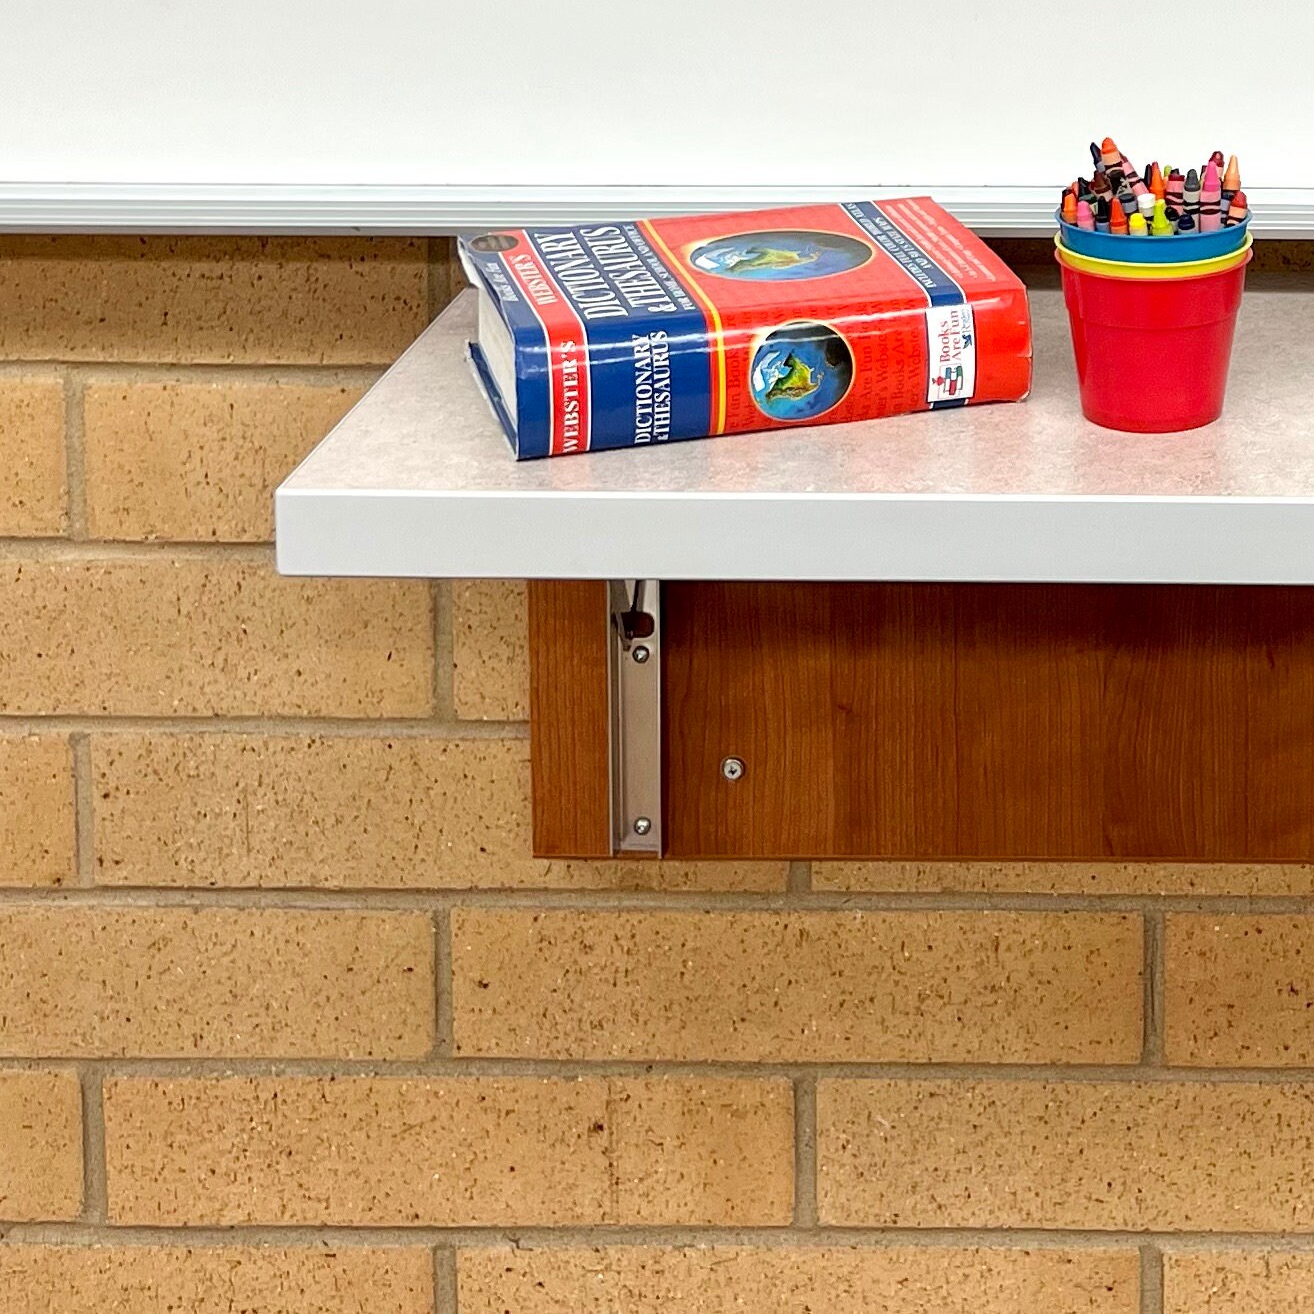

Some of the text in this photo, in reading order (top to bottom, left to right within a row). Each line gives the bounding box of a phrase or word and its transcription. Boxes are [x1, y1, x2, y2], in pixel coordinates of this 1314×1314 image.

[507, 253, 559, 305] WEBSTER'S
[533, 231, 628, 319] DICTIONARY
[937, 320, 950, 362] Books
[949, 310, 961, 361] Are Fun
[560, 340, 580, 452] WEBSTER'S
[632, 333, 652, 443] DICTIONARY
